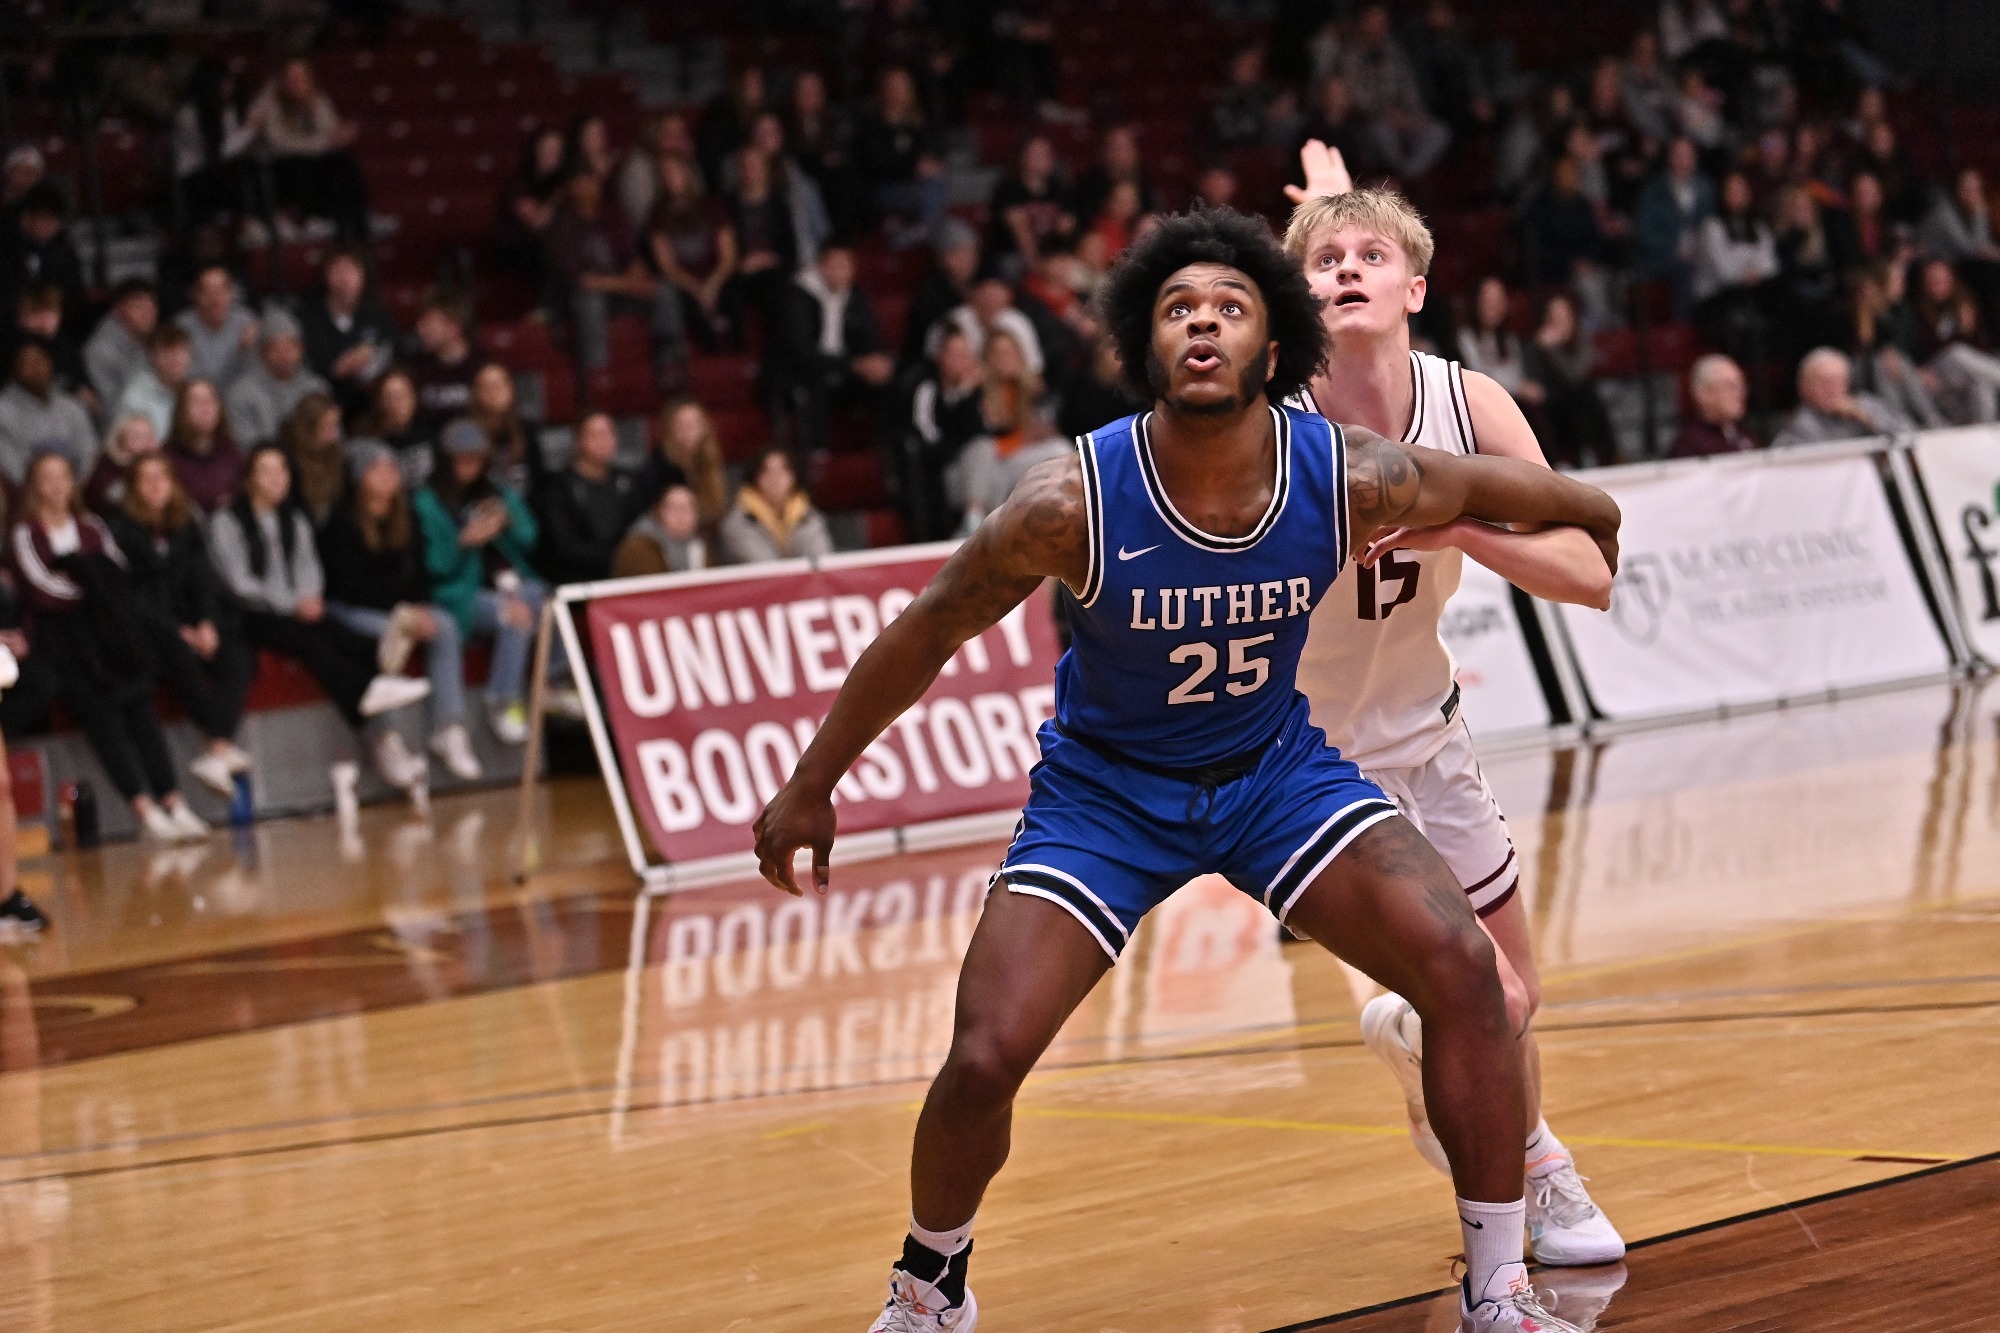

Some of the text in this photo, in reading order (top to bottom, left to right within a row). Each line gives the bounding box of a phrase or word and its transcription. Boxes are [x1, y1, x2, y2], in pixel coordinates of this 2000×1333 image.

[1130, 576, 1311, 630] LUTHER
[1356, 543, 1421, 620] 15
[609, 586, 1032, 718] UNIVERY
[1167, 632, 1275, 705] 25
